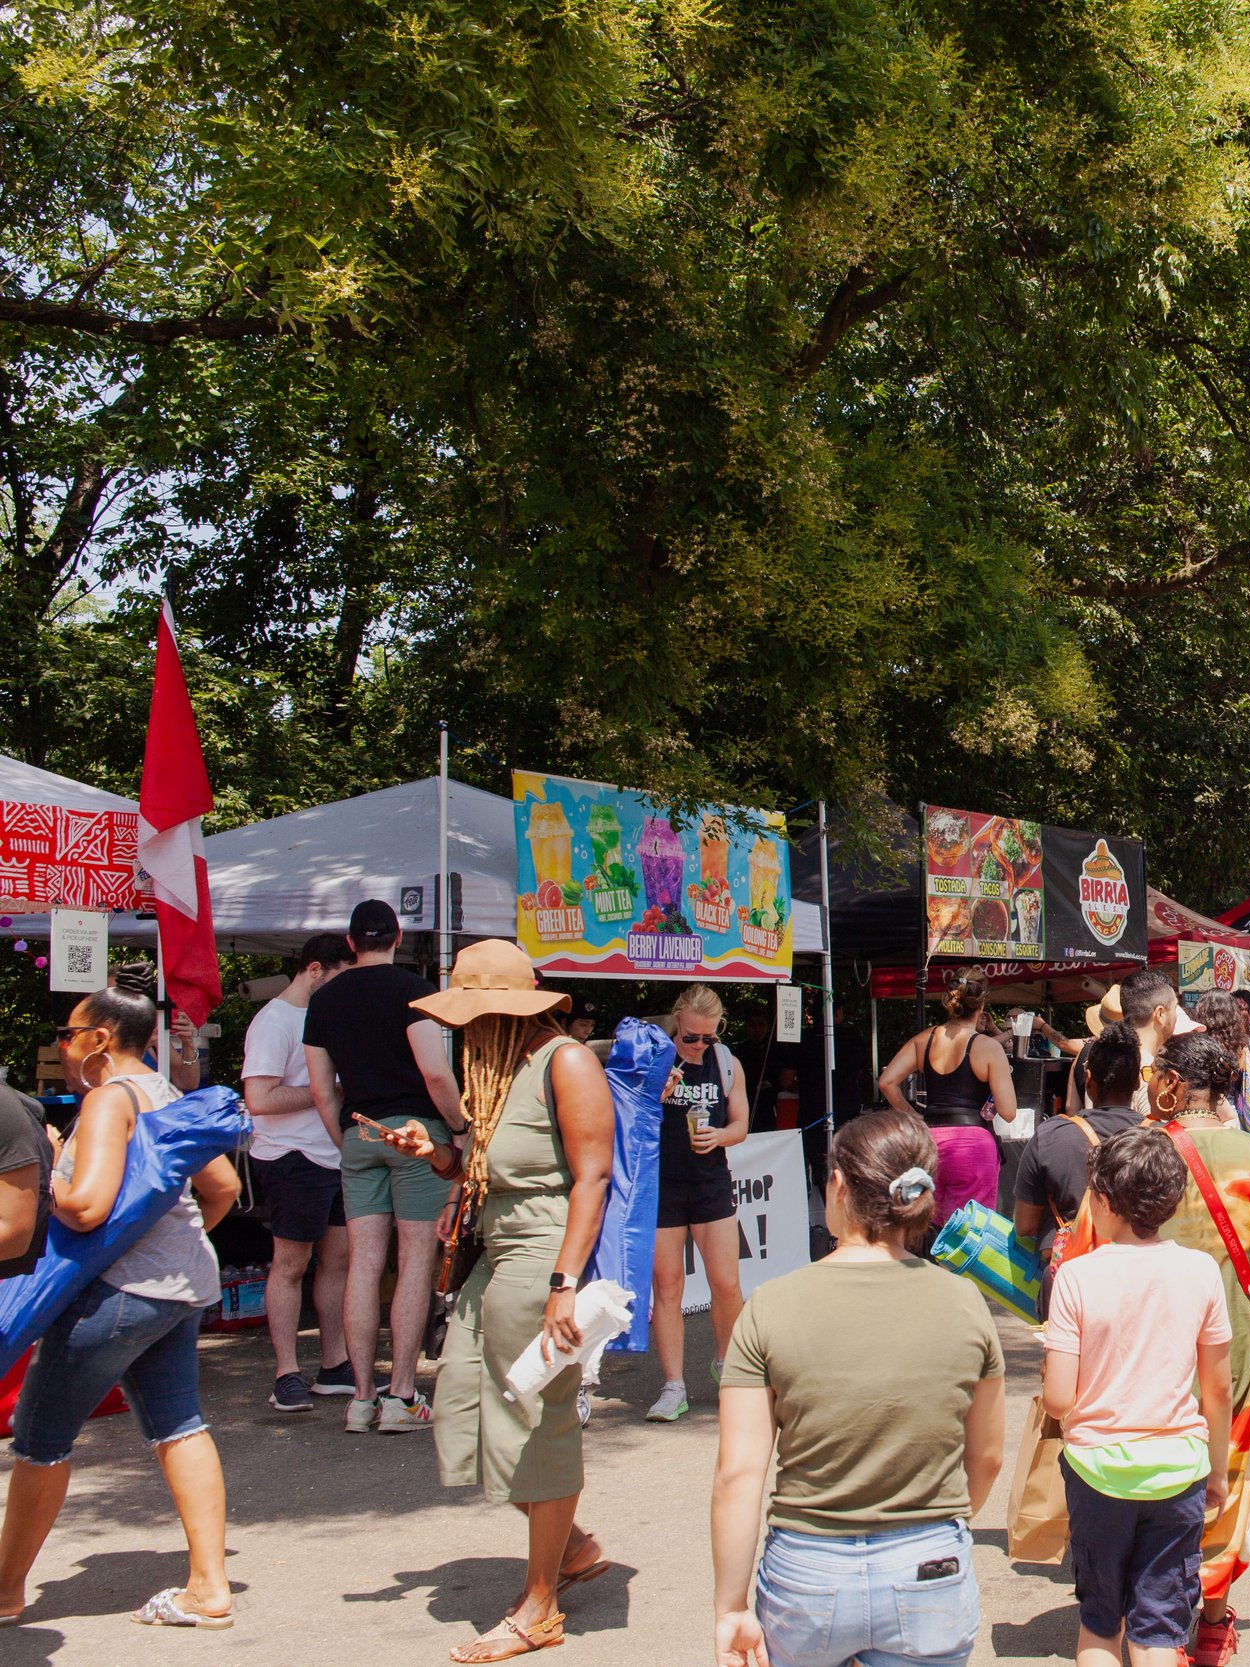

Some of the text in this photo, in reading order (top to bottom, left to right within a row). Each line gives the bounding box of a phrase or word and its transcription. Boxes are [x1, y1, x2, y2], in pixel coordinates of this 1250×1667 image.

[934, 877, 966, 894] TOSTADA
[980, 882, 1000, 896] TACOS
[1081, 879, 1128, 906] BIRRIA
[595, 889, 632, 913] MINT TEA
[537, 909, 566, 933] GREEN
[566, 908, 584, 931] TEA
[696, 900, 717, 923] BLACK
[718, 907, 730, 928] TEA
[629, 934, 701, 961] BERRY LAVENDER
[743, 924, 767, 947] OOLONG
[767, 931, 778, 951] TEA
[979, 943, 1007, 957] CONSOME
[1015, 944, 1039, 957] ESQUITE
[665, 1098, 689, 1106] NNEX
[673, 1083, 719, 1100] ossFit
[1216, 1211, 1241, 1257] LOUIS VUITTON
